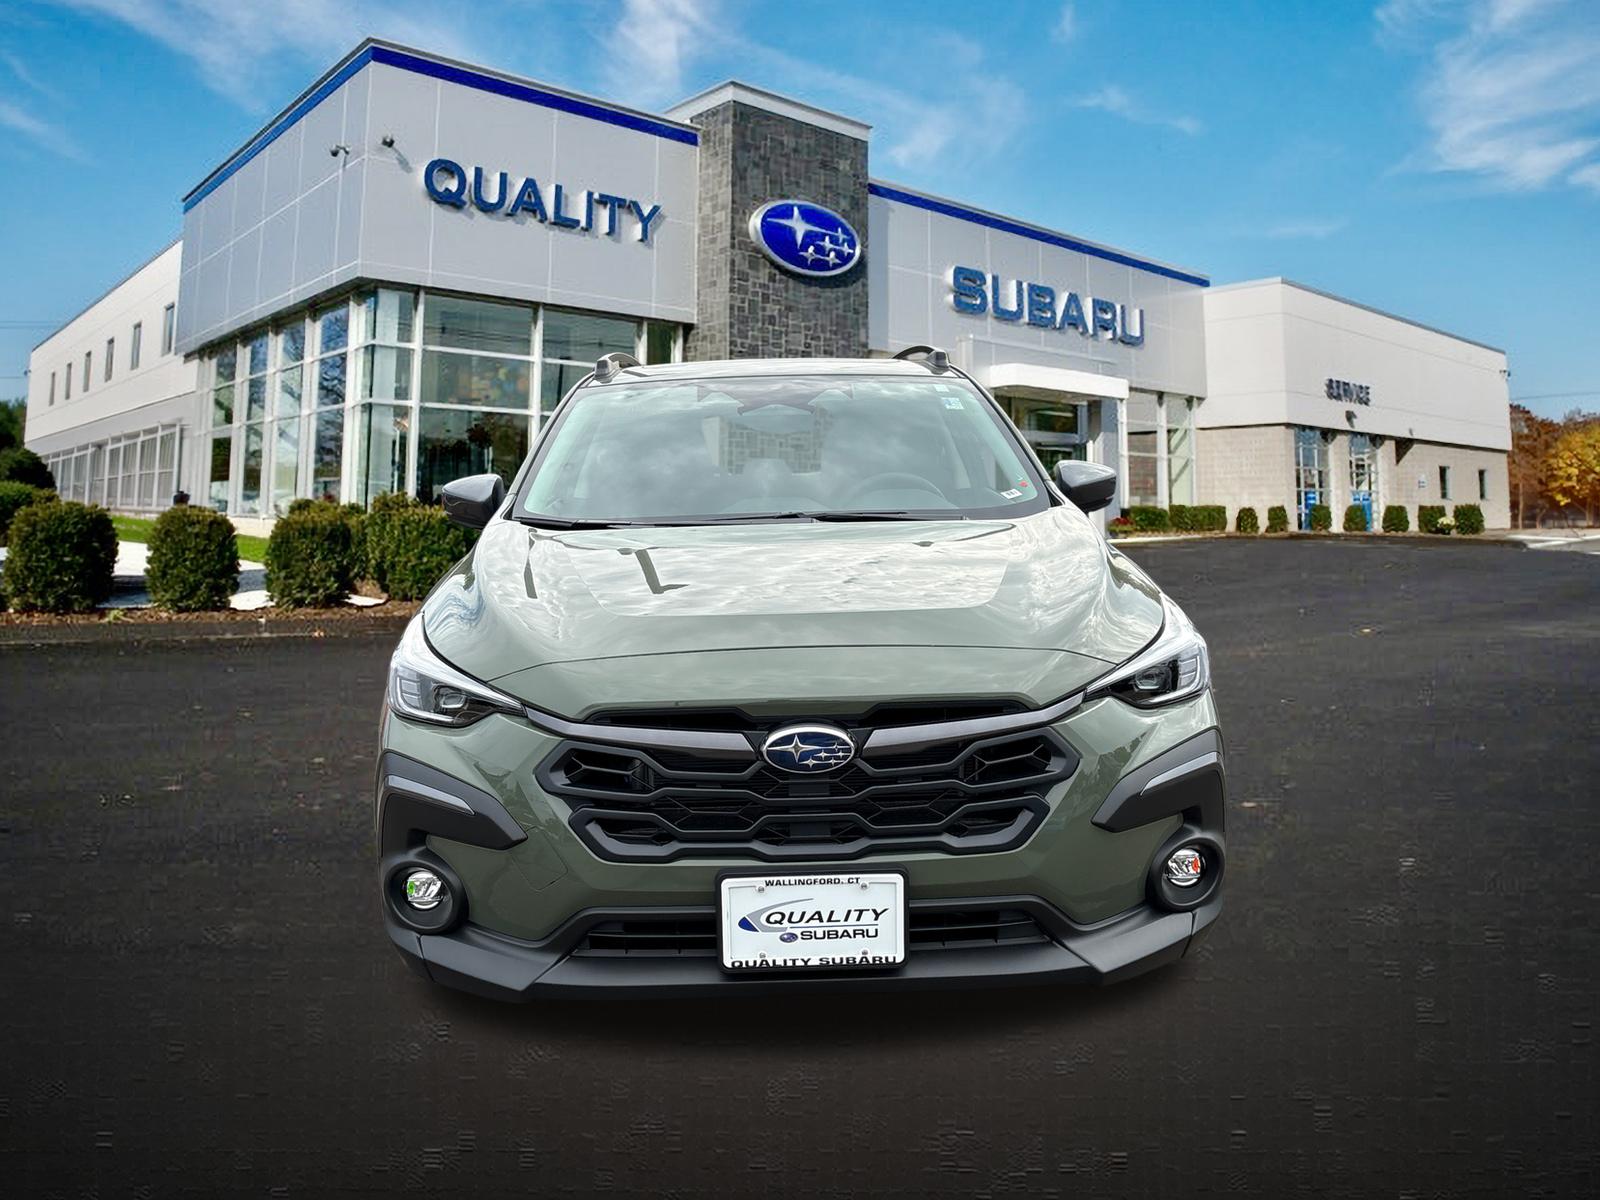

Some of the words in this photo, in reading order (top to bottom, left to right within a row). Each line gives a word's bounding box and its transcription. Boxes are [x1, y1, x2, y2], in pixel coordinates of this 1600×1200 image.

[424, 158, 661, 243] QUALITY
[949, 265, 1145, 346] SUBARU
[1325, 378, 1371, 406] SERVICE
[847, 877, 860, 885] CT
[765, 908, 889, 925] QUALITY
[801, 928, 879, 941] SUBARU
[731, 958, 811, 968] QUALITY
[819, 956, 896, 966] SUBARU
